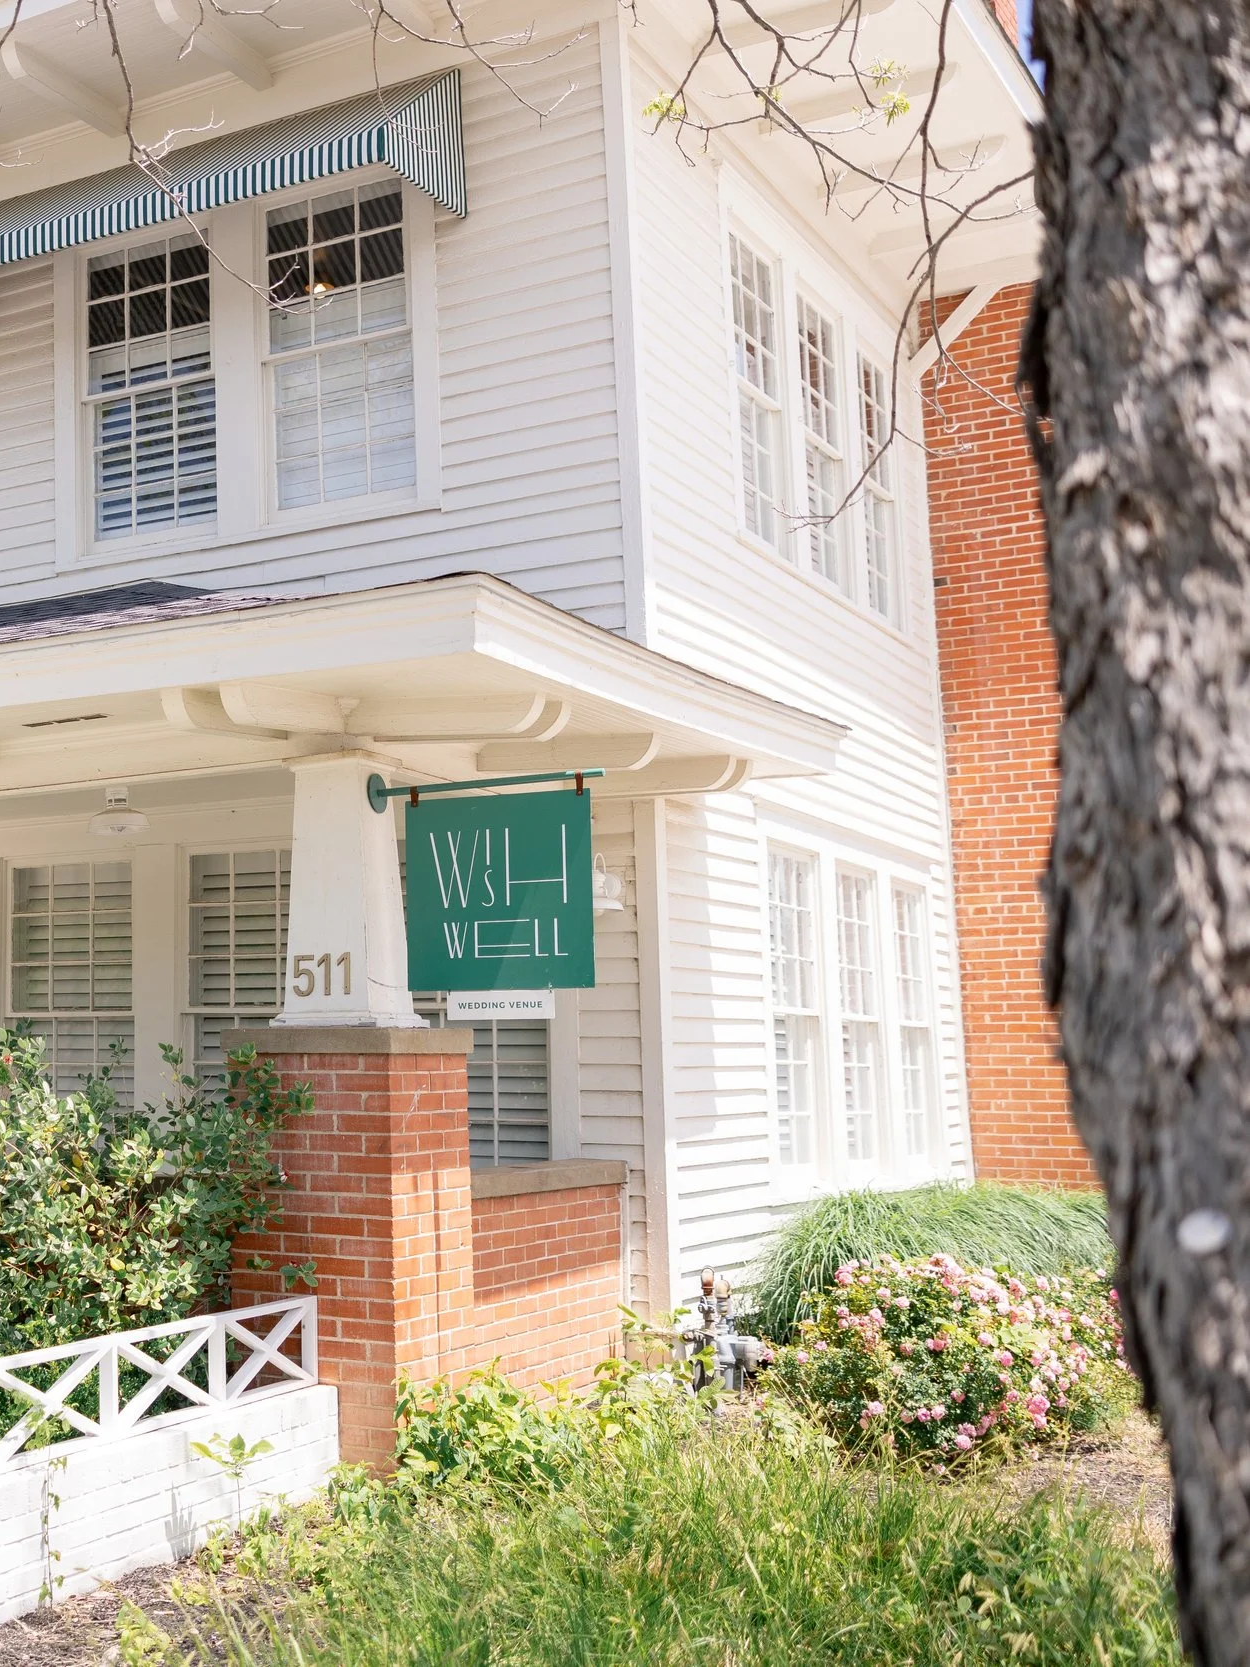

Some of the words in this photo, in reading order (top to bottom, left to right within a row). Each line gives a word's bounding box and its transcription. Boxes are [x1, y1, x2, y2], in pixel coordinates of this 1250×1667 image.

[429, 823, 568, 909] WISH
[443, 917, 569, 959] WELL
[292, 951, 351, 998] 511
[457, 1001, 506, 1010] WEDDING
[509, 1000, 543, 1009] VENUE
